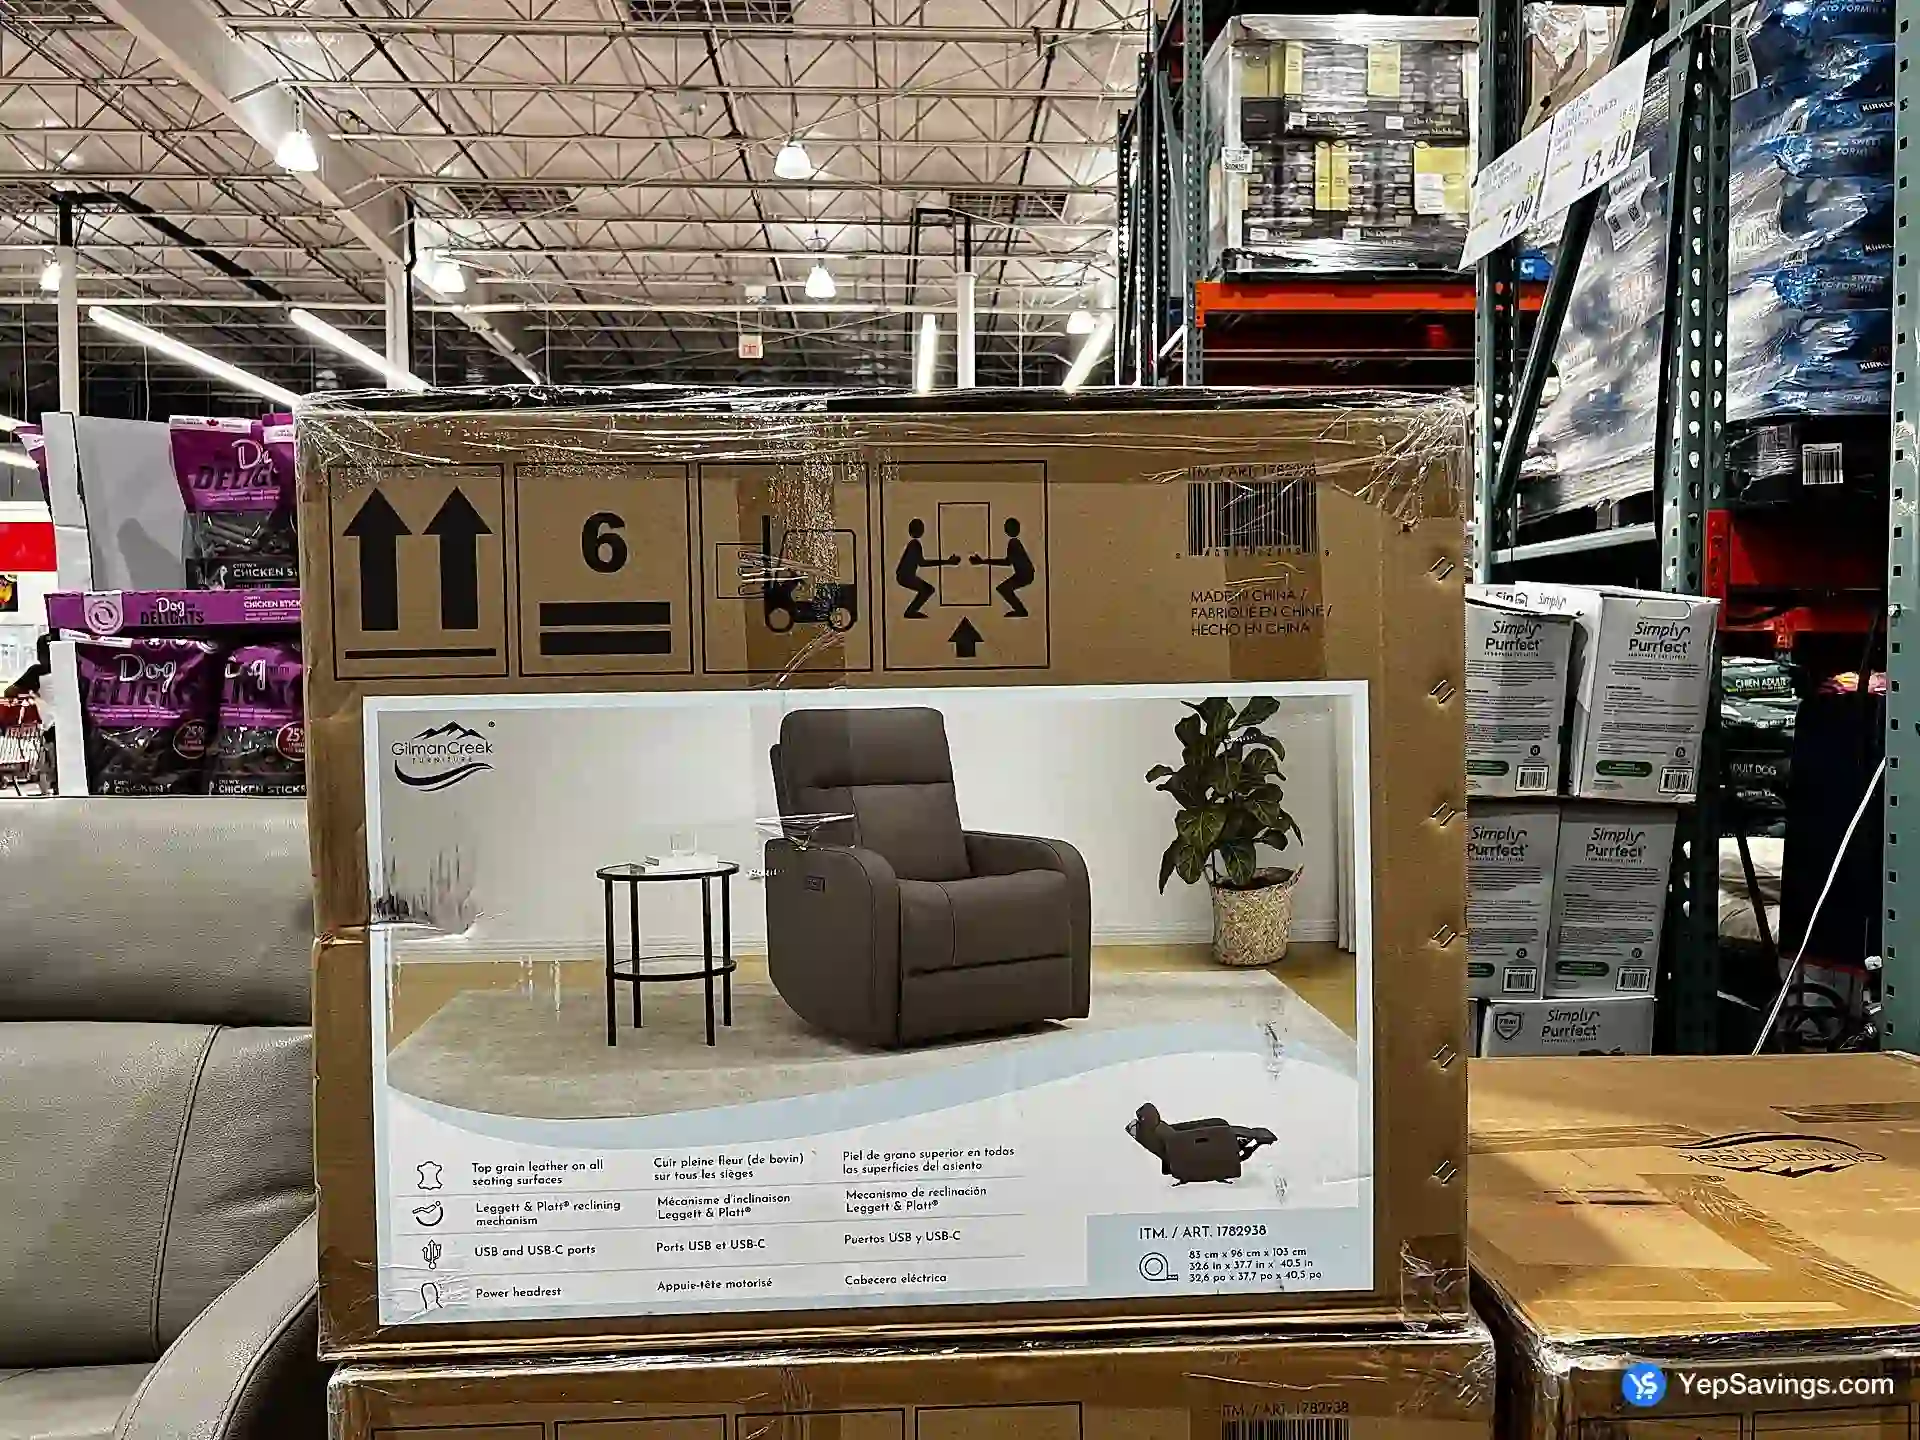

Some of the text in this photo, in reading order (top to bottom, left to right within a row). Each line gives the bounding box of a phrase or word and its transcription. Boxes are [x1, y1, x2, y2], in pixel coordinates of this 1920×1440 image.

[1862, 101, 1895, 112] KIRKLA
[1579, 130, 1631, 190] 13.49
[1500, 194, 1535, 239] 7.99
[580, 511, 628, 574] 6
[233, 566, 284, 578] CHICKEN
[1252, 589, 1297, 601] CHINA
[156, 597, 185, 616] Dog
[244, 600, 301, 608] CHICKEN STICK
[1260, 606, 1277, 618] EN
[1281, 603, 1325, 618] CHINE
[140, 611, 205, 625] DELIGHTS
[1191, 620, 1311, 636] HECHO EN CHINA
[1492, 619, 1542, 639] Simply
[1634, 621, 1691, 641] Simply
[1485, 637, 1541, 651] Purrfect
[1629, 638, 1689, 654] Purrfect
[112, 653, 177, 693] Dog
[391, 740, 495, 756] GilmanCreek
[1730, 763, 1754, 773] DULT
[219, 784, 264, 794] CHICKEN
[1471, 825, 1528, 845] Simply
[1590, 826, 1646, 846] Simply
[1468, 843, 1526, 858] Purrfect
[1585, 843, 1644, 858] Purrfect
[1547, 1006, 1601, 1026] Simply
[1541, 1024, 1598, 1038] Purrfect
[653, 1152, 804, 1170] Cuir pleine fleur (de bovin)
[843, 1145, 1015, 1163] Piel de grano superior en todas
[472, 1157, 603, 1174] Top grain leather on all
[843, 1160, 983, 1175] las superficies del asiento
[472, 1174, 563, 1188] seating surfaces
[653, 1167, 754, 1182] sur tous les sièges
[657, 1192, 791, 1207] Mécanisme d'inclinaison
[846, 1185, 987, 1200] Mecanismo de reclinación
[476, 1200, 621, 1215] Leggett & Platt® reclining
[657, 1205, 752, 1222] Leggett & Platt®
[846, 1199, 939, 1215] Leggett & Platt®
[476, 1215, 538, 1227] mechanism
[844, 1230, 961, 1246] Puertos USB y USB-C
[1139, 1224, 1268, 1240] ITM. / ART. 1782938
[475, 1244, 596, 1257] USB and USB-C ports
[656, 1238, 766, 1253] Ports USB et USB-C
[1204, 1251, 1219, 1259] cm
[1246, 1250, 1261, 1258] cm
[1272, 1248, 1289, 1257] 103
[1292, 1248, 1307, 1256] cm
[1189, 1261, 1209, 1272] 32.6
[1233, 1260, 1253, 1270] 37.7
[1280, 1259, 1301, 1269] 40.5
[845, 1272, 947, 1286] Cabecera eléctrica
[1189, 1273, 1210, 1283] 32,6
[1237, 1272, 1257, 1282] 37,7
[1284, 1270, 1306, 1280] 40,5
[476, 1286, 562, 1299] Power headrest
[656, 1277, 773, 1293] Appuie-tête motorisé
